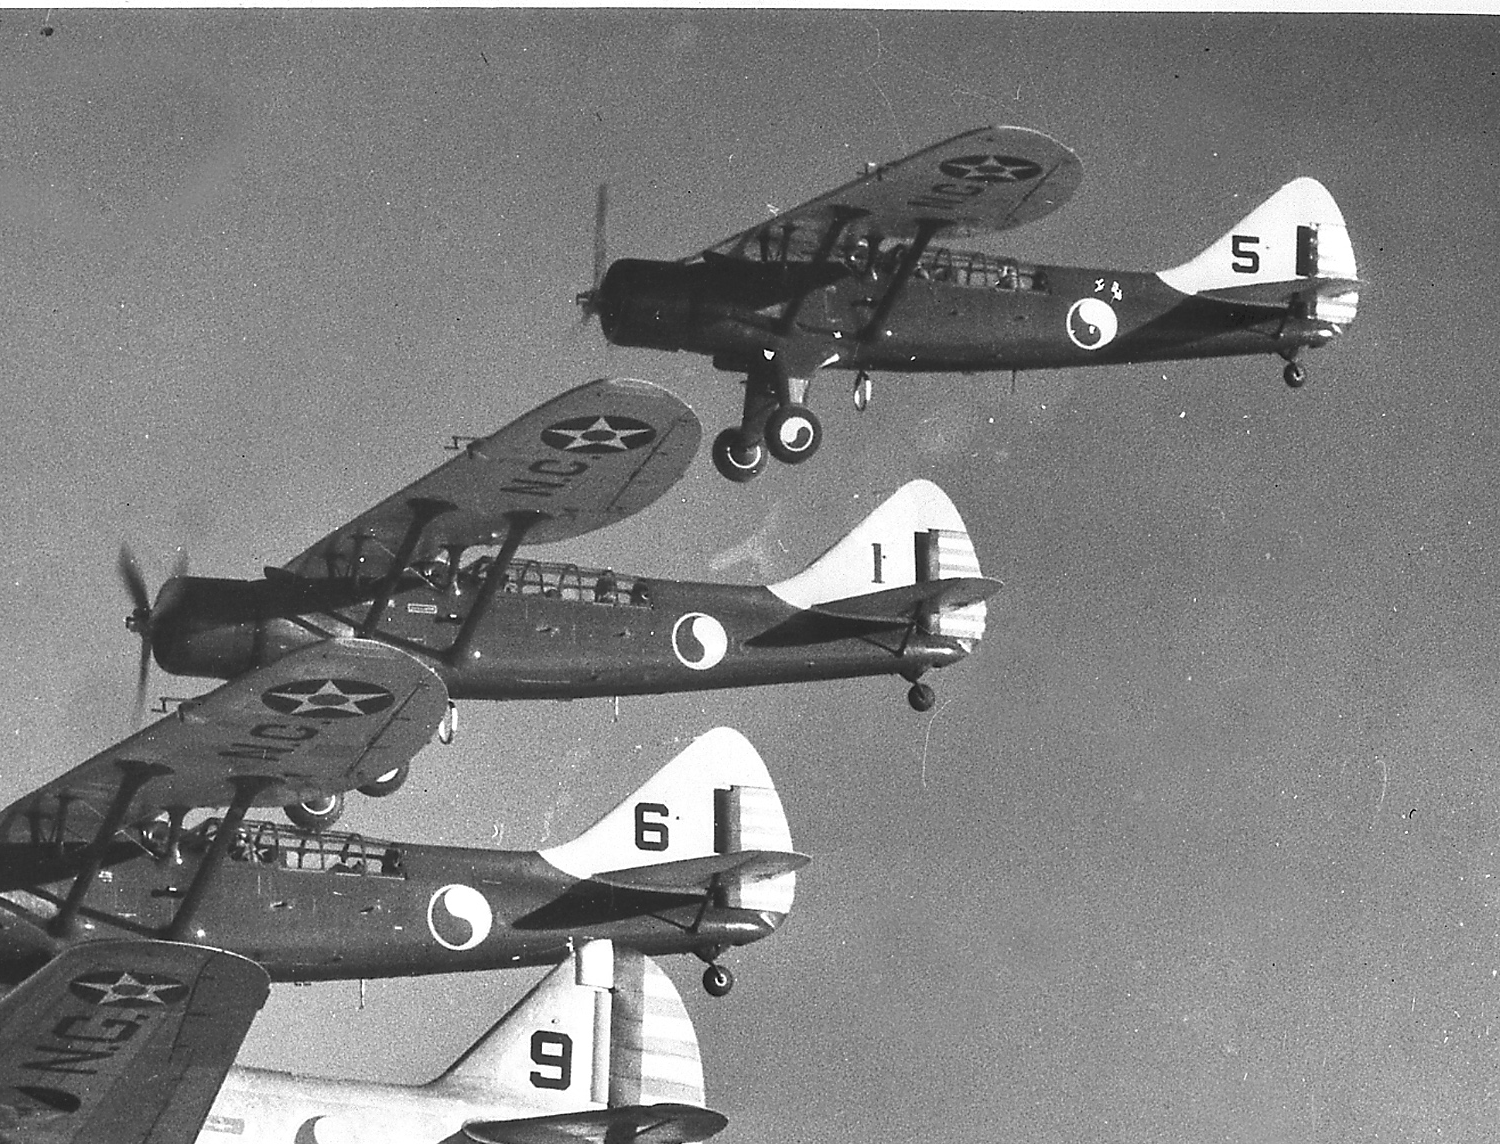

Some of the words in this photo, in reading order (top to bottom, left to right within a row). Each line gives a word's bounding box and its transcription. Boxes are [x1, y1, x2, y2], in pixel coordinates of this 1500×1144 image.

[1231, 234, 1260, 274] 5
[634, 802, 669, 851] 6
[529, 1030, 573, 1091] 9
